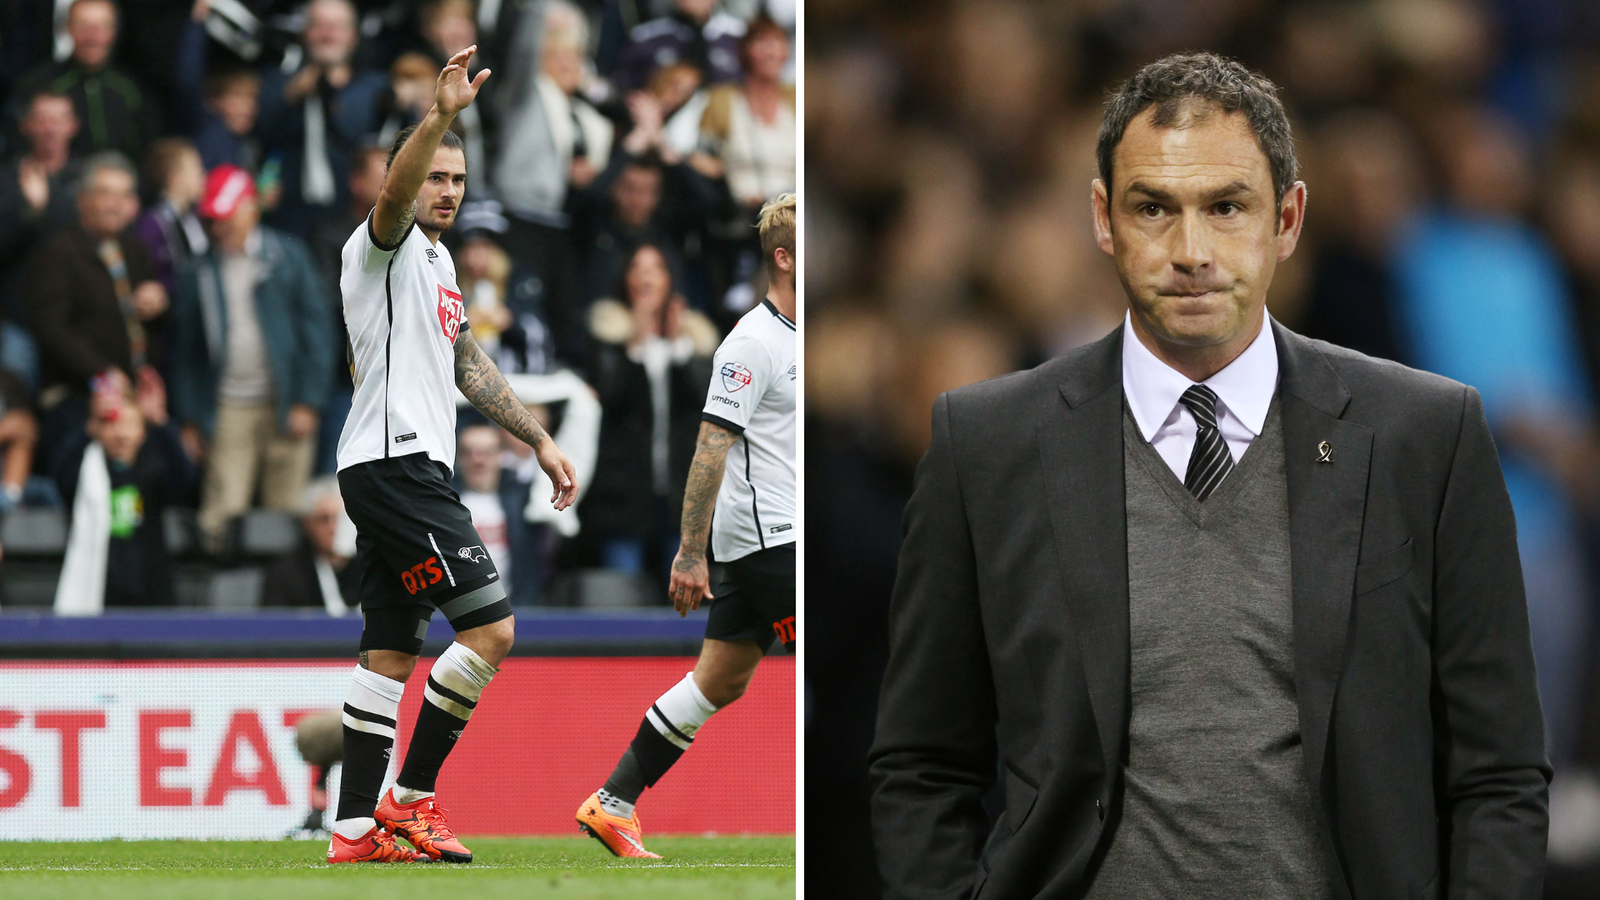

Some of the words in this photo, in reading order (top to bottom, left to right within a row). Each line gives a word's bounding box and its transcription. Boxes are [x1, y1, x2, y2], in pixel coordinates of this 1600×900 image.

[441, 291, 462, 319] JUST
[722, 368, 735, 378] sky
[734, 372, 750, 384] BET
[711, 394, 740, 409] umbro
[401, 556, 443, 595] QTS
[773, 615, 796, 645] QT
